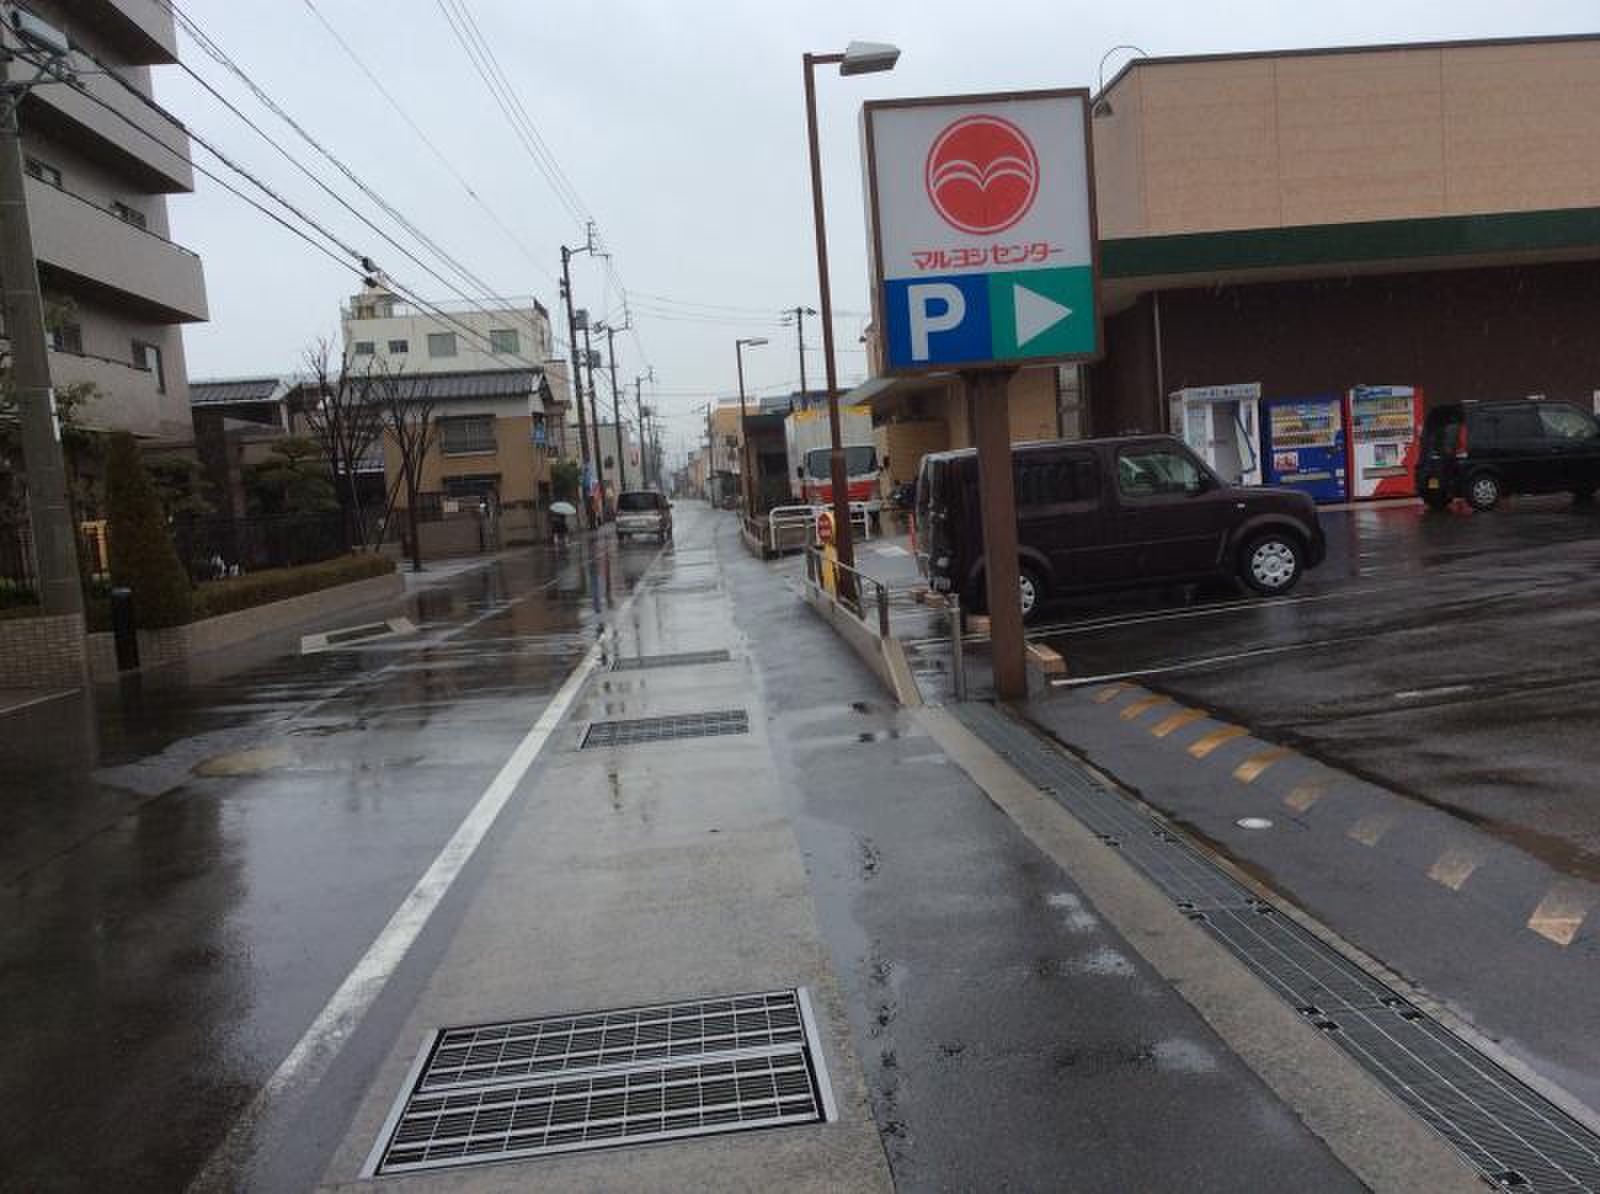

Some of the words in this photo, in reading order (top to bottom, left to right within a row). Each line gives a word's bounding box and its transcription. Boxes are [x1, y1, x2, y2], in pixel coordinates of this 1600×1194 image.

[912, 243, 1064, 270] マルヨシセンター
[908, 283, 966, 361] P
